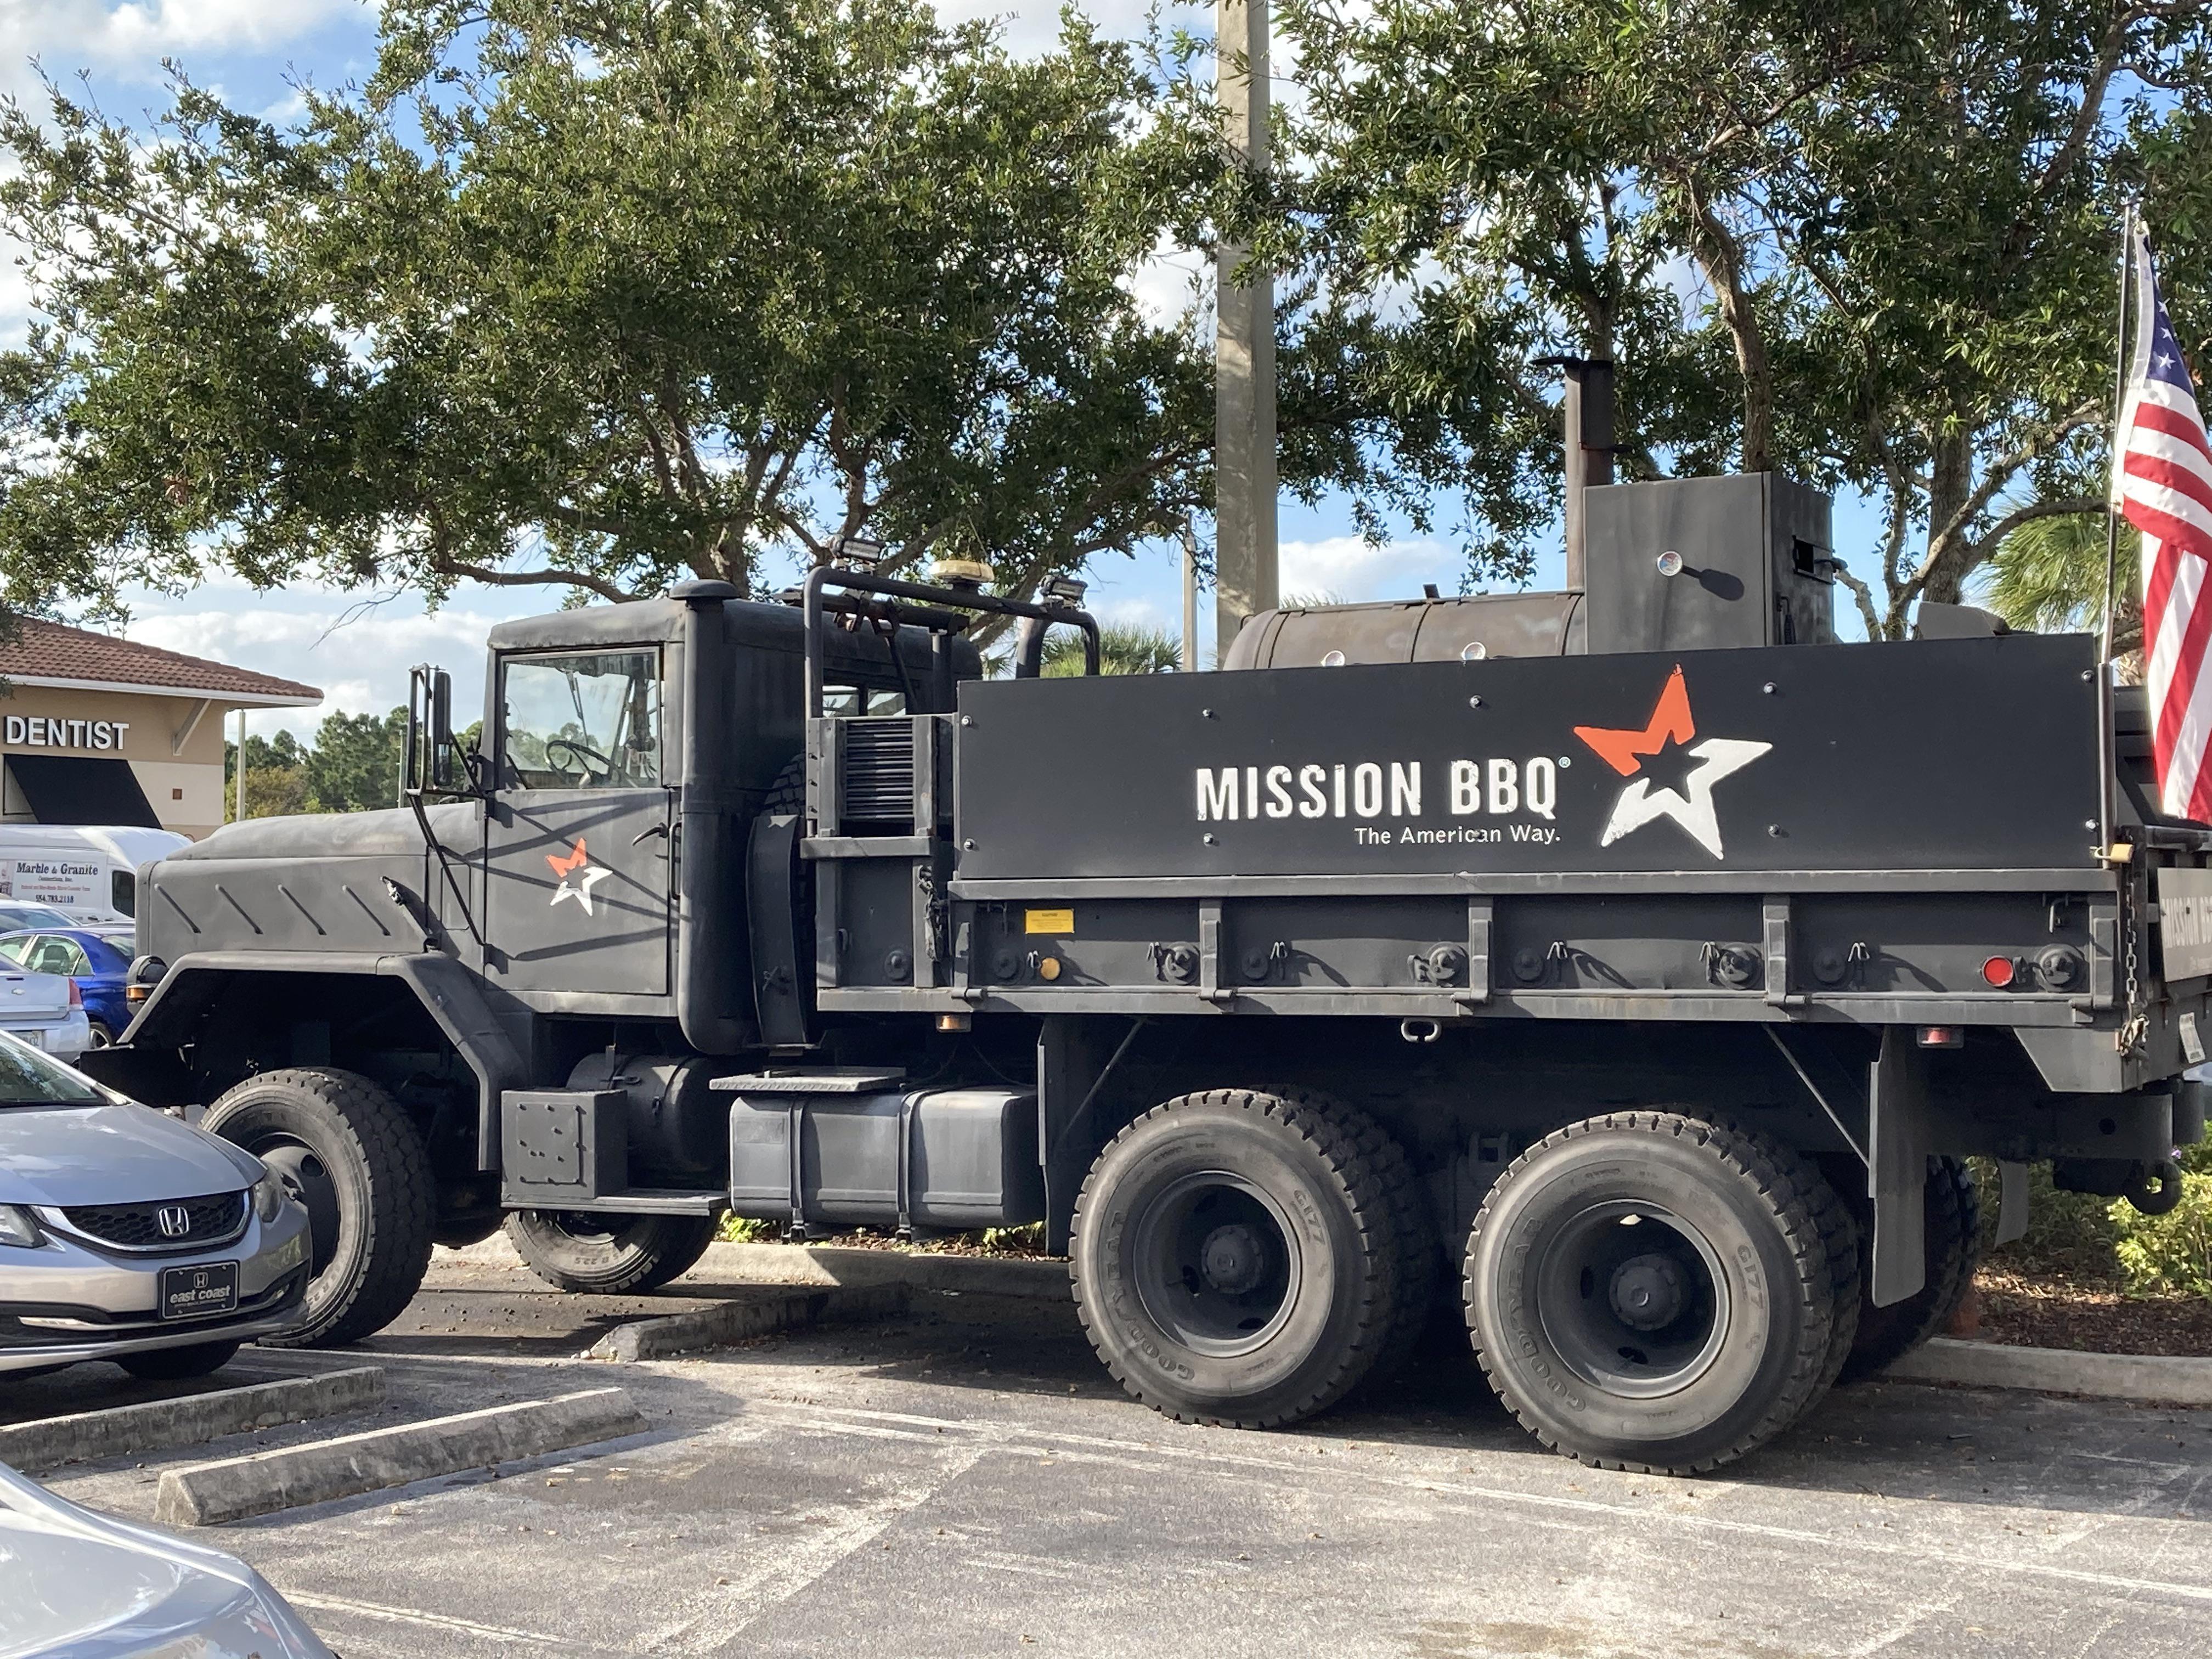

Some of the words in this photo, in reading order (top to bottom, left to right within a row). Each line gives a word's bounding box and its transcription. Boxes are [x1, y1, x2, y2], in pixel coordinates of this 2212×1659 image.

[5, 715, 129, 750] DENTIST
[1196, 761, 1421, 821] MISSION
[1354, 827, 1391, 845] The
[1400, 826, 1502, 844] American
[1509, 824, 1560, 845] Way.
[16, 862, 49, 874] Marble
[60, 863, 98, 876] Granite
[2161, 897, 2200, 949] MISSION
[170, 1289, 196, 1304] east
[198, 1285, 231, 1300] coast
[1105, 1211, 1195, 1381] GOODYEAR
[1737, 1244, 1764, 1309] G177
[1509, 1217, 1586, 1412] GOODYEAR
